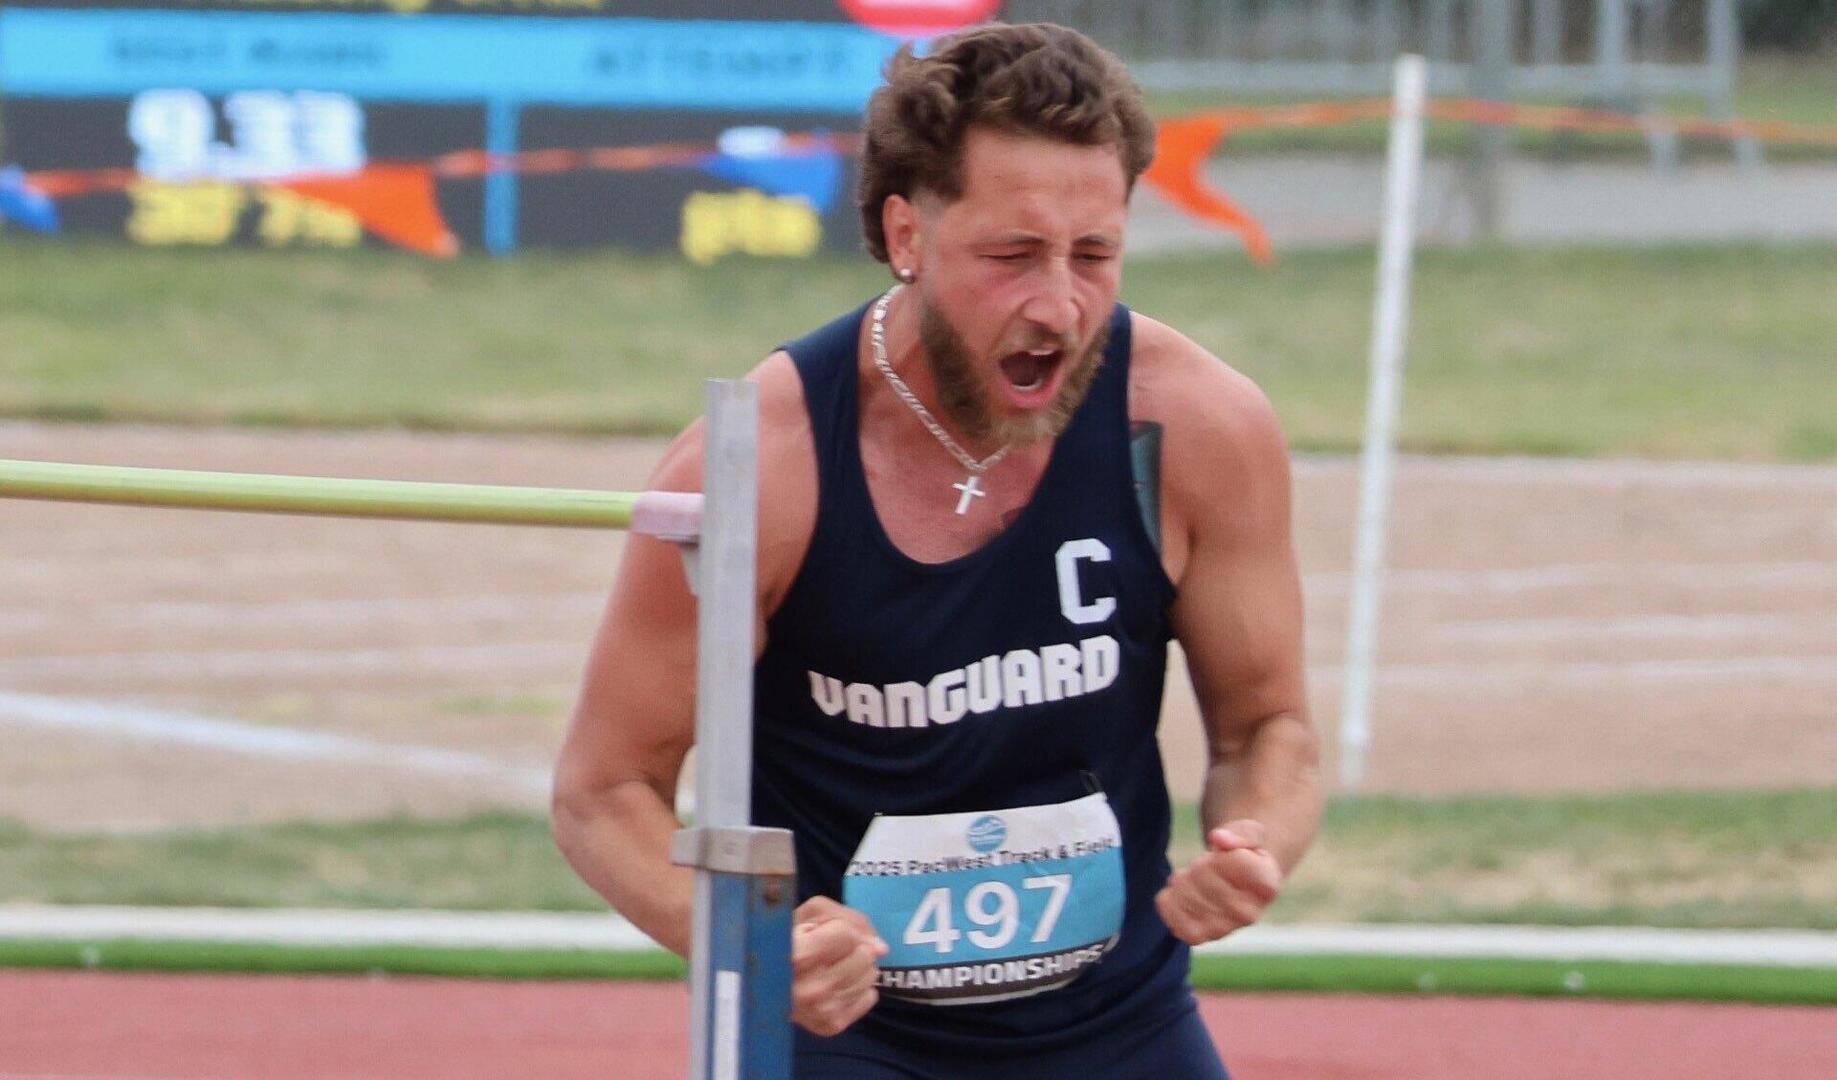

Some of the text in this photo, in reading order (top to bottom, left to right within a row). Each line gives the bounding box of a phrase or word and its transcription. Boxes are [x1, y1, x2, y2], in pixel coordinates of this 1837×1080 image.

[1055, 538, 1117, 625] C
[807, 634, 1120, 728] VANGUARD
[849, 859, 901, 876] 2025
[995, 848, 1050, 866] Track
[1058, 845, 1069, 858] &
[903, 873, 1072, 954] 497
